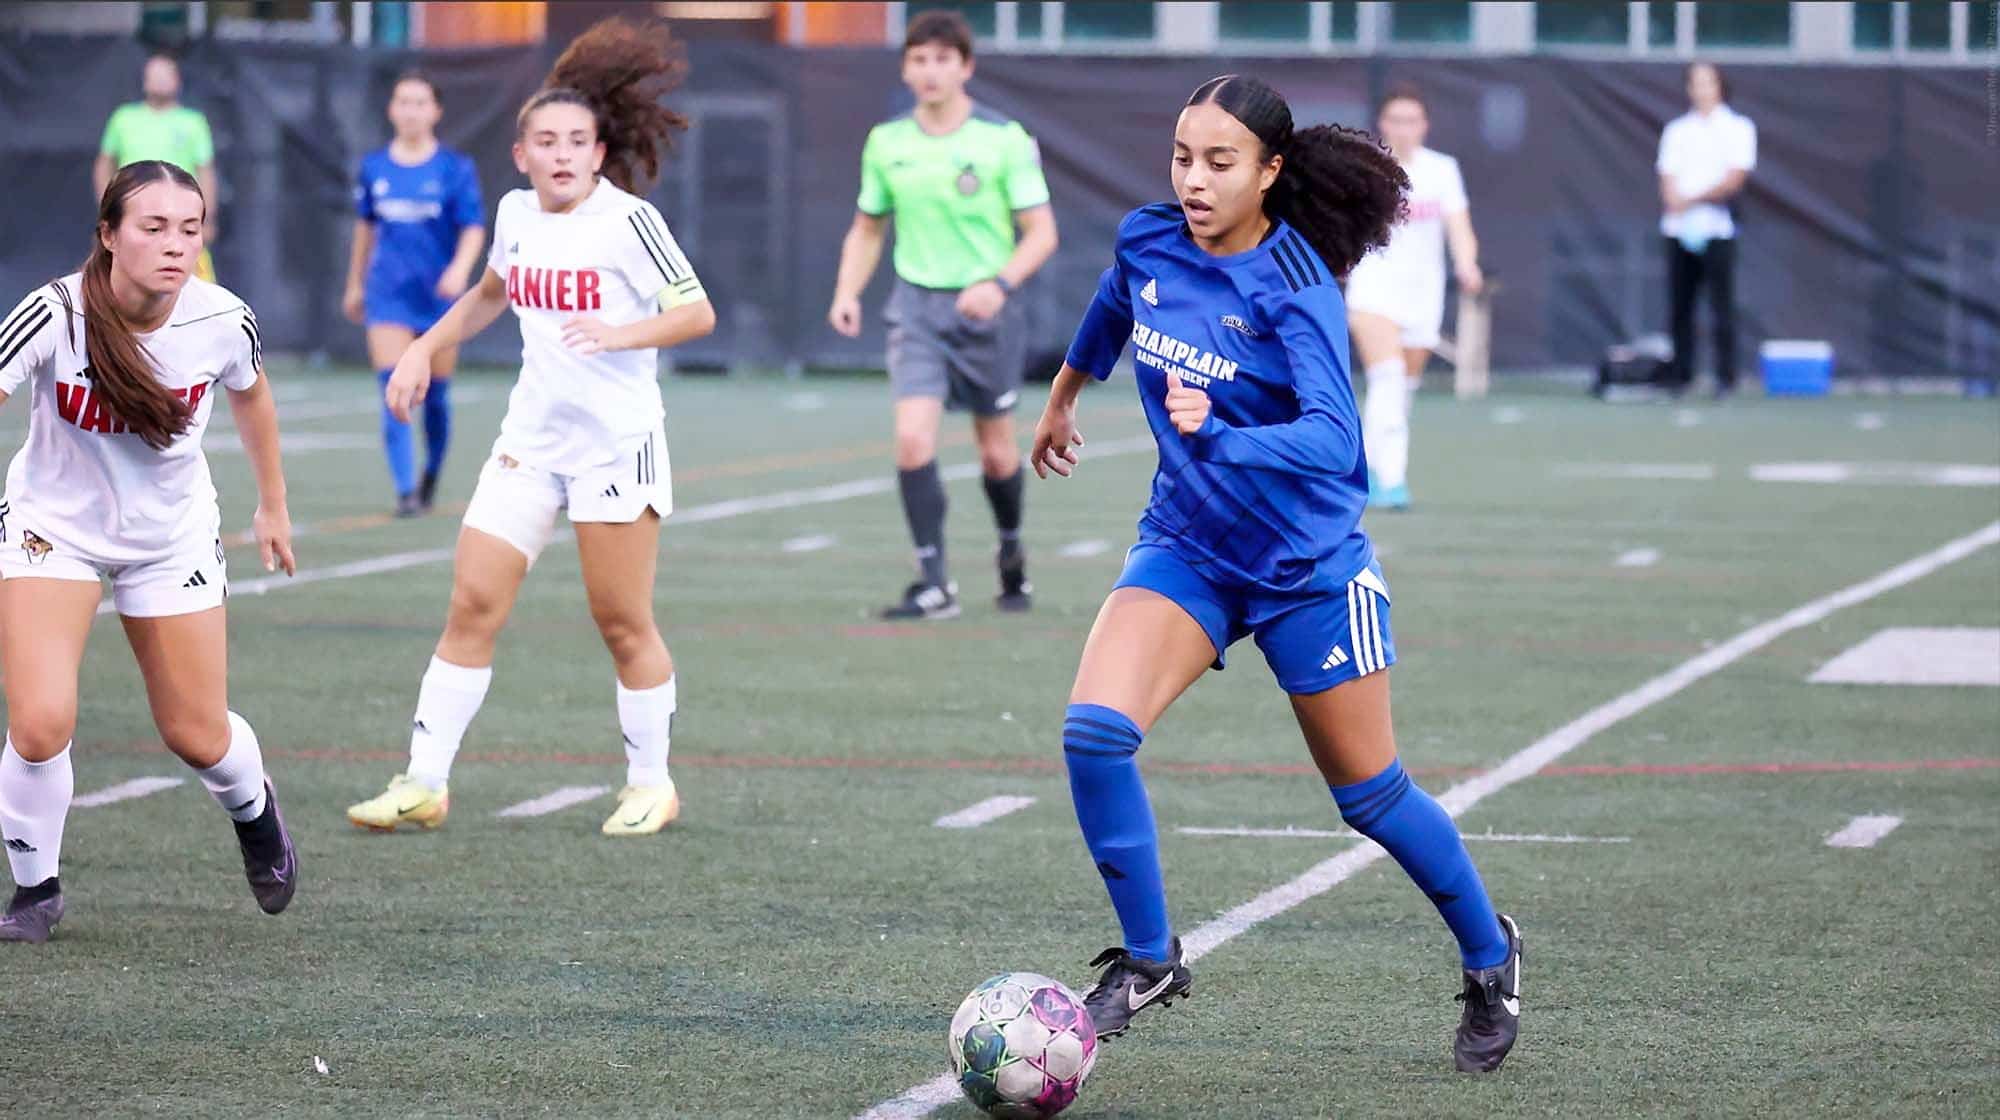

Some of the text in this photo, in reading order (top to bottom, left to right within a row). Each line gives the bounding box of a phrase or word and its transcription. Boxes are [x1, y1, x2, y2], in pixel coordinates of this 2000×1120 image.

[508, 264, 601, 312] ANIER
[1132, 320, 1239, 382] CHAMPLAIN
[56, 381, 209, 434] VAR
